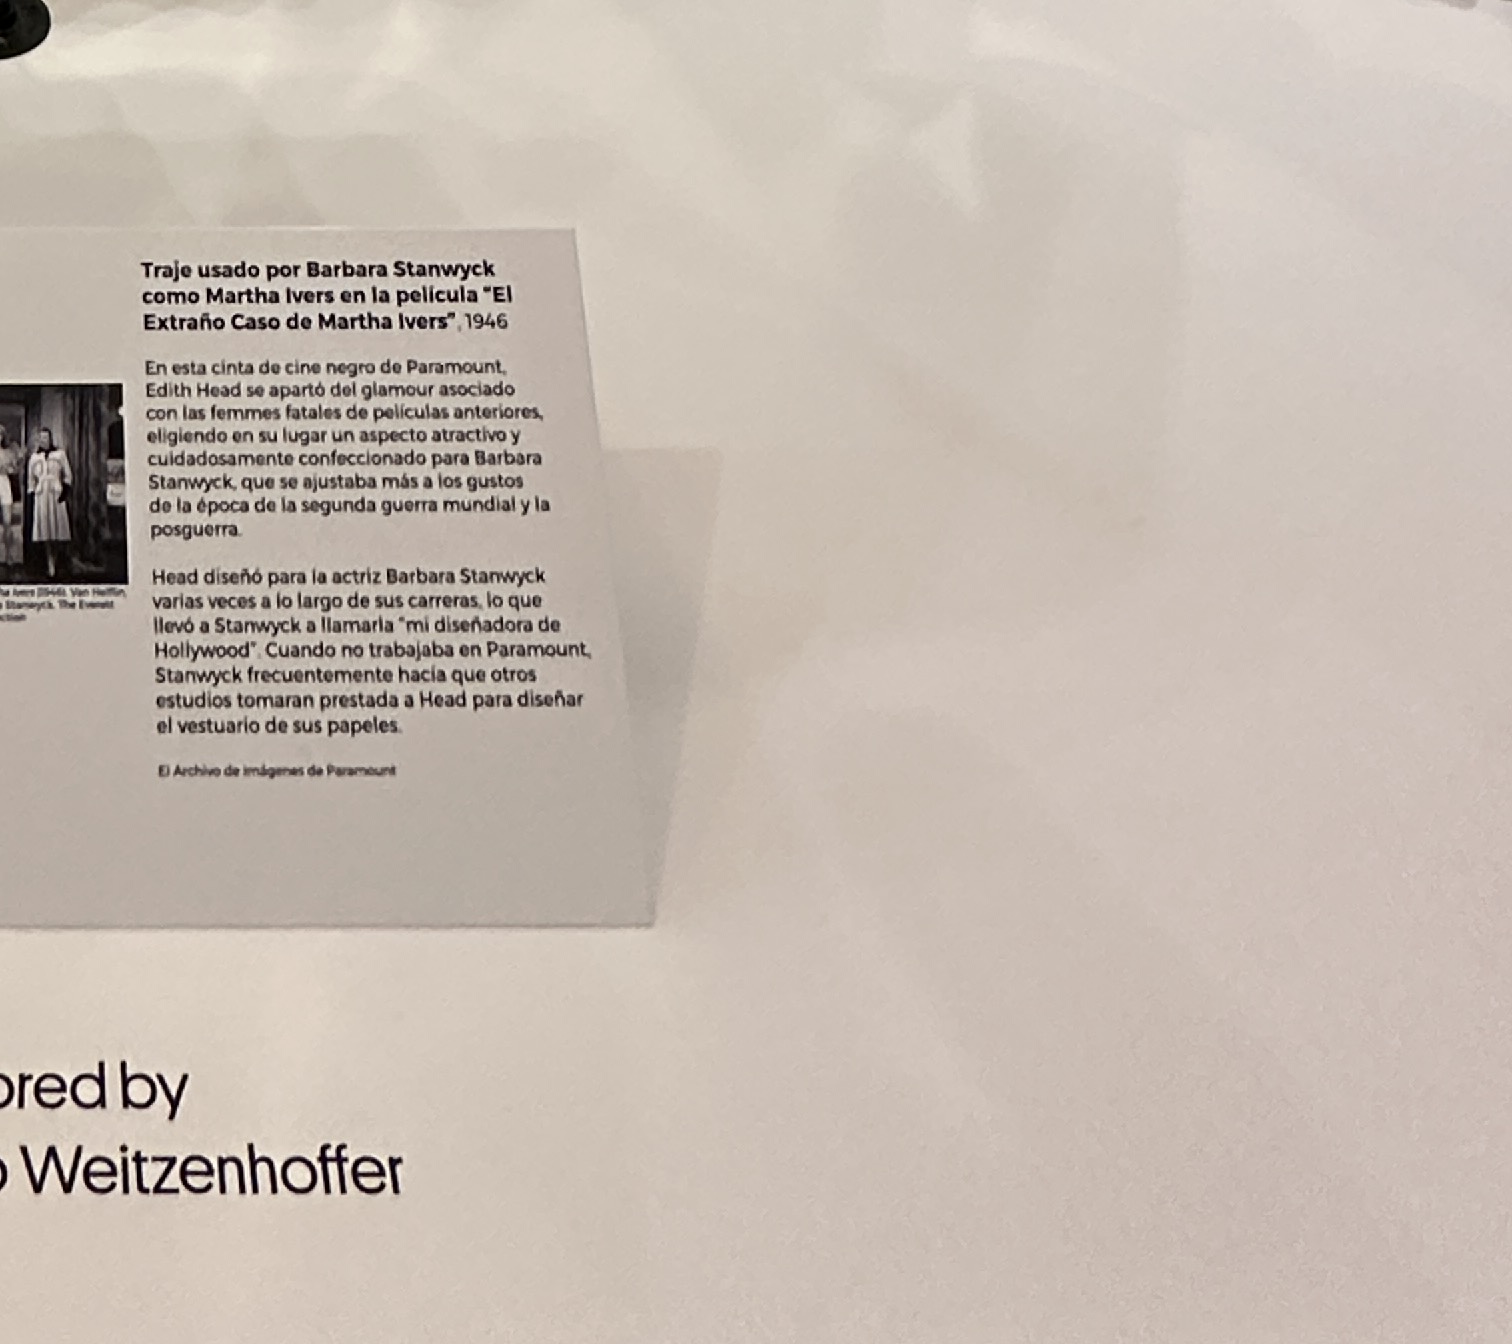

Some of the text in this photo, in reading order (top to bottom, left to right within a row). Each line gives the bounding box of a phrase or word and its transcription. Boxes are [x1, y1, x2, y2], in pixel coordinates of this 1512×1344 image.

[140, 259, 496, 281] Traje usado por Barbara Stanwyck
[142, 291, 200, 305] como
[205, 287, 280, 304] Martha
[285, 287, 336, 303] Ivers
[340, 291, 366, 303] en
[371, 286, 391, 303] la
[396, 285, 479, 307] película
[143, 313, 226, 331] Extraño
[230, 313, 281, 330] Caso
[285, 312, 313, 330] de
[318, 312, 394, 330] Martha
[464, 313, 508, 329] 1946
[152, 567, 546, 588] Head diseñó para la actriz Barbara Stanwyck
[151, 593, 204, 609] varias
[207, 596, 257, 609] veces
[260, 596, 272, 609] a
[276, 592, 294, 609] lo
[296, 591, 344, 613] largo
[346, 591, 370, 609] de
[374, 595, 404, 609] sus
[486, 591, 504, 608] lo
[508, 595, 543, 612] que
[153, 617, 195, 634] llevó
[198, 621, 210, 633] a
[214, 617, 302, 637] Stanwyck
[306, 621, 317, 633] a
[320, 615, 394, 633] llamarla
[434, 616, 534, 633] diseñadora
[537, 616, 562, 633] de
[264, 641, 336, 659] Cuando
[340, 645, 364, 658] no
[368, 641, 455, 661] trabajaba
[458, 645, 482, 657] en
[154, 665, 538, 687] Stanwyck frecuentemente hacía que otros
[155, 690, 584, 712] estudios tomaran prestada a Head para diseñar
[156, 716, 173, 734] el
[176, 716, 261, 734] vestuario
[264, 716, 289, 733] de
[292, 720, 323, 733] sus
[121, 1060, 189, 1121] by
[19, 1143, 403, 1195] Weitzenhoffer
